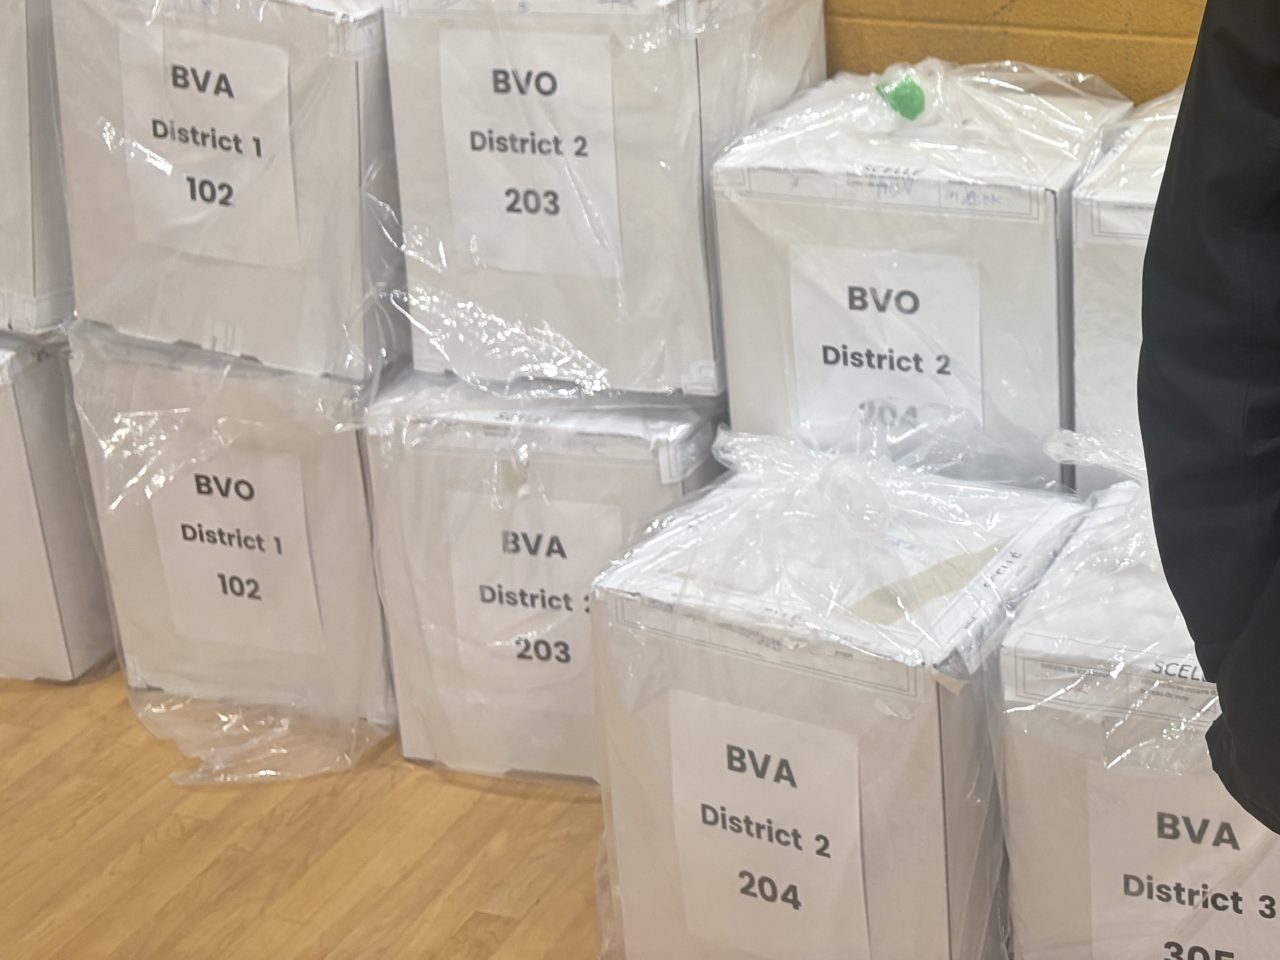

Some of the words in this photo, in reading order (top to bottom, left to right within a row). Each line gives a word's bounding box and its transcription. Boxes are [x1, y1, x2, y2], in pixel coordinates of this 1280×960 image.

[172, 64, 235, 99] BVA
[491, 68, 558, 97] BVO
[151, 118, 243, 155] District
[252, 136, 262, 158] 1
[470, 128, 564, 156] District
[573, 135, 589, 157] 2
[185, 175, 235, 207] 102
[504, 187, 561, 216] 203
[847, 284, 921, 316] BVO
[822, 343, 925, 374] District
[935, 353, 952, 376] 2
[194, 473, 256, 502] BVO
[180, 523, 266, 553] District
[273, 535, 283, 556] 1
[501, 530, 568, 560] BVA
[217, 572, 263, 602] 102
[479, 583, 574, 613] District
[514, 636, 572, 664] 203
[1151, 660, 1207, 682] SCEL
[726, 743, 798, 789] BVA
[700, 802, 804, 852] District
[814, 833, 832, 859] 2
[1156, 810, 1241, 852] BVA
[737, 869, 803, 911] 204
[1122, 872, 1244, 916] District
[1257, 894, 1277, 920] 3
